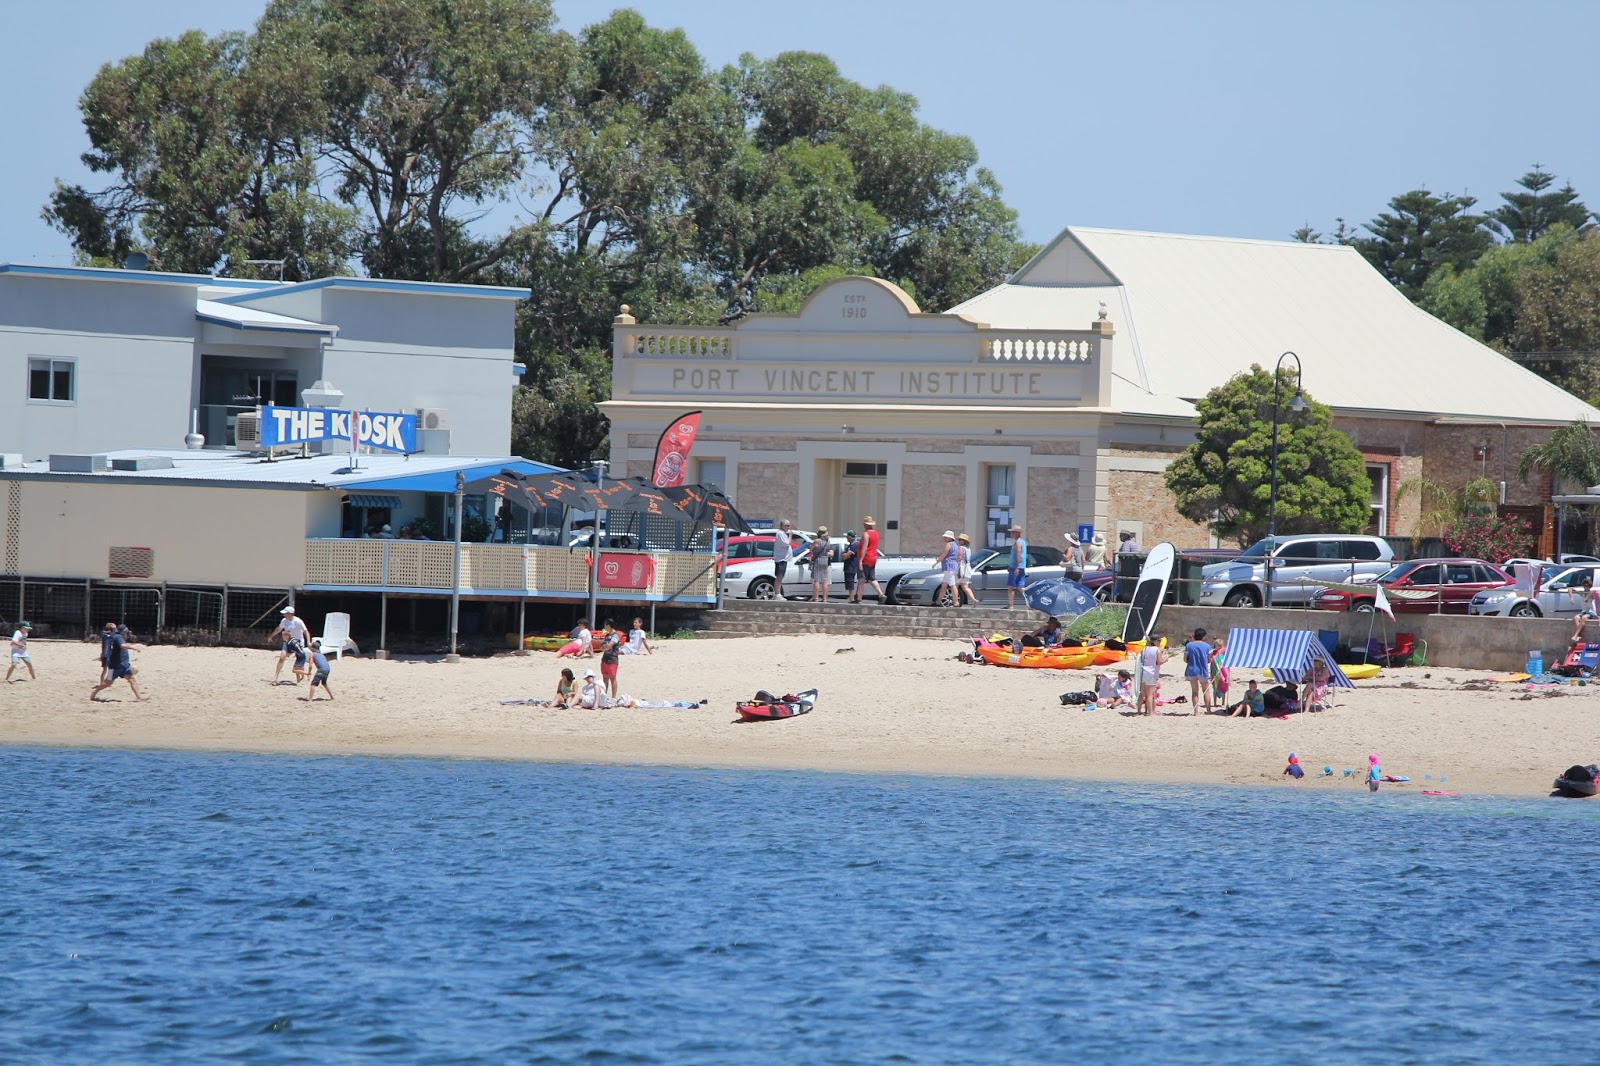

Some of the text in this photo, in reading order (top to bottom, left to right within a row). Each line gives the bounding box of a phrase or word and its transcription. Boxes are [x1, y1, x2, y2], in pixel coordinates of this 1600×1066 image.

[842, 307, 867, 318] 1910
[672, 368, 1041, 394] PORT VINCENT INSTITUTE
[272, 409, 324, 442] THE
